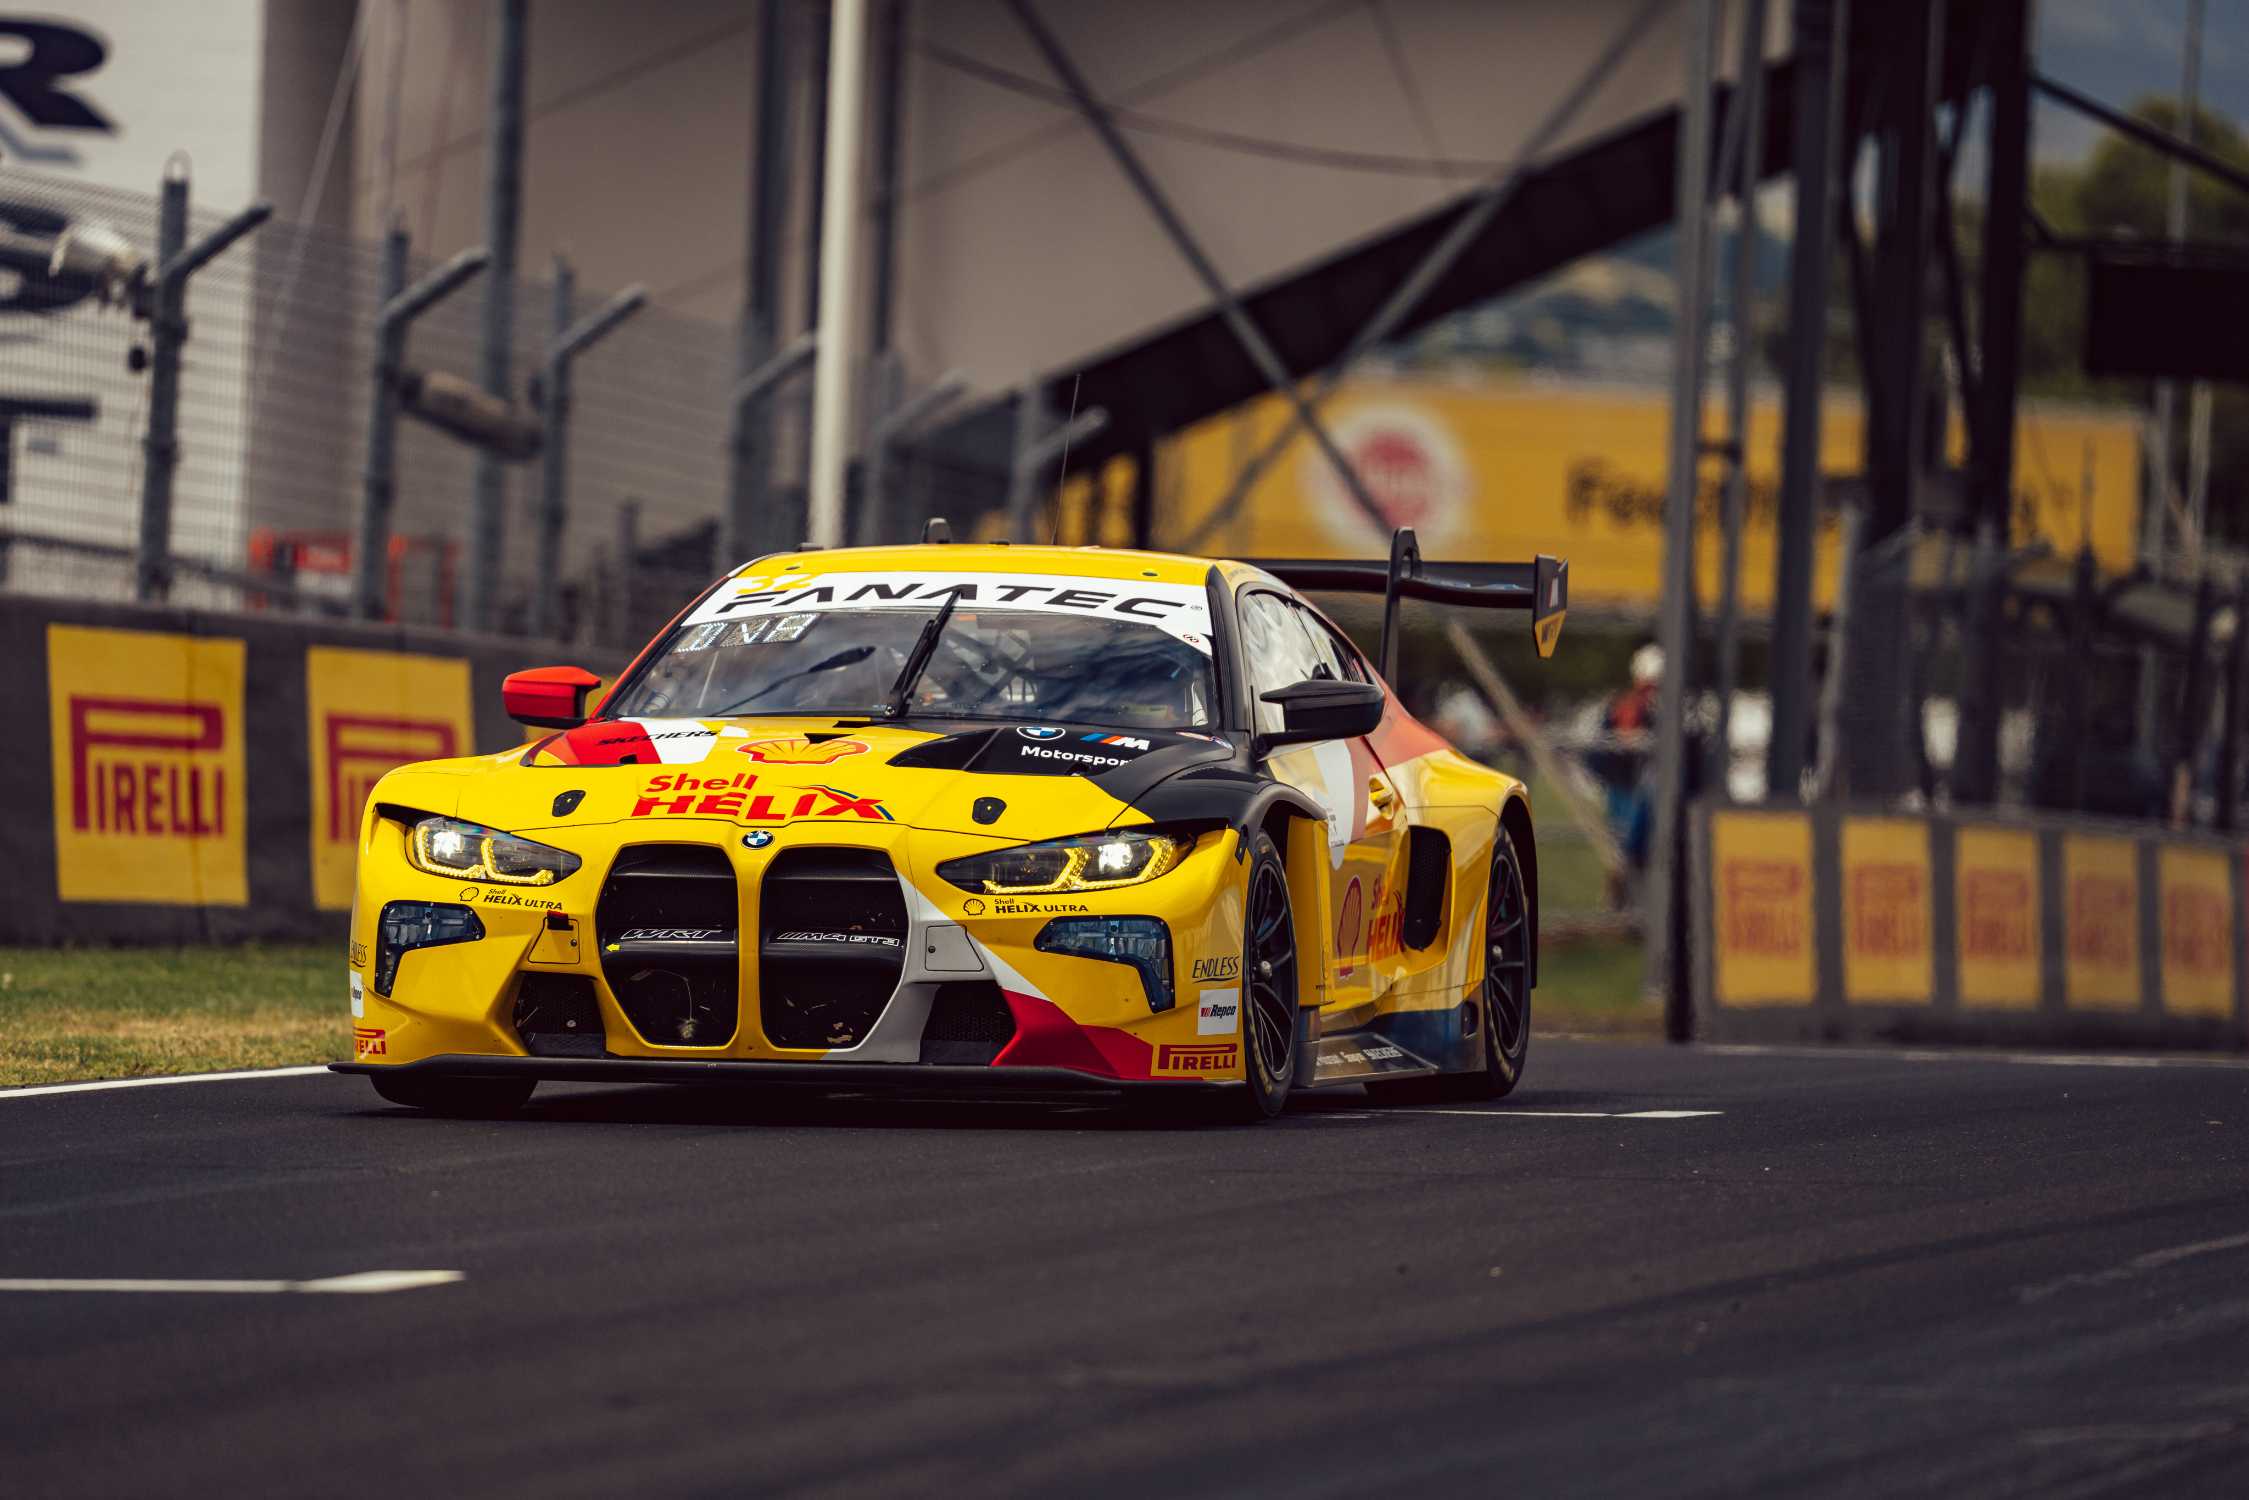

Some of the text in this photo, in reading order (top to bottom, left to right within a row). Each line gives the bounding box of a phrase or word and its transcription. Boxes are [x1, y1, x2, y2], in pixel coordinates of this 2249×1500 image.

[735, 572, 825, 595] 32
[715, 583, 1187, 619] FANATEC
[69, 694, 225, 837] PIRELLI
[1021, 745, 1134, 768] Motorspor
[645, 773, 759, 793] Shell
[631, 786, 887, 821] HELIX
[483, 893, 563, 911] HELIX ULTRA
[488, 888, 507, 896] Shell
[995, 903, 1090, 914] HELIX ULTRA
[620, 928, 722, 940] WRT
[1192, 956, 1240, 980] ENDLESS
[1210, 1004, 1237, 1019] Repco
[1158, 1043, 1238, 1071] PIRELLI
